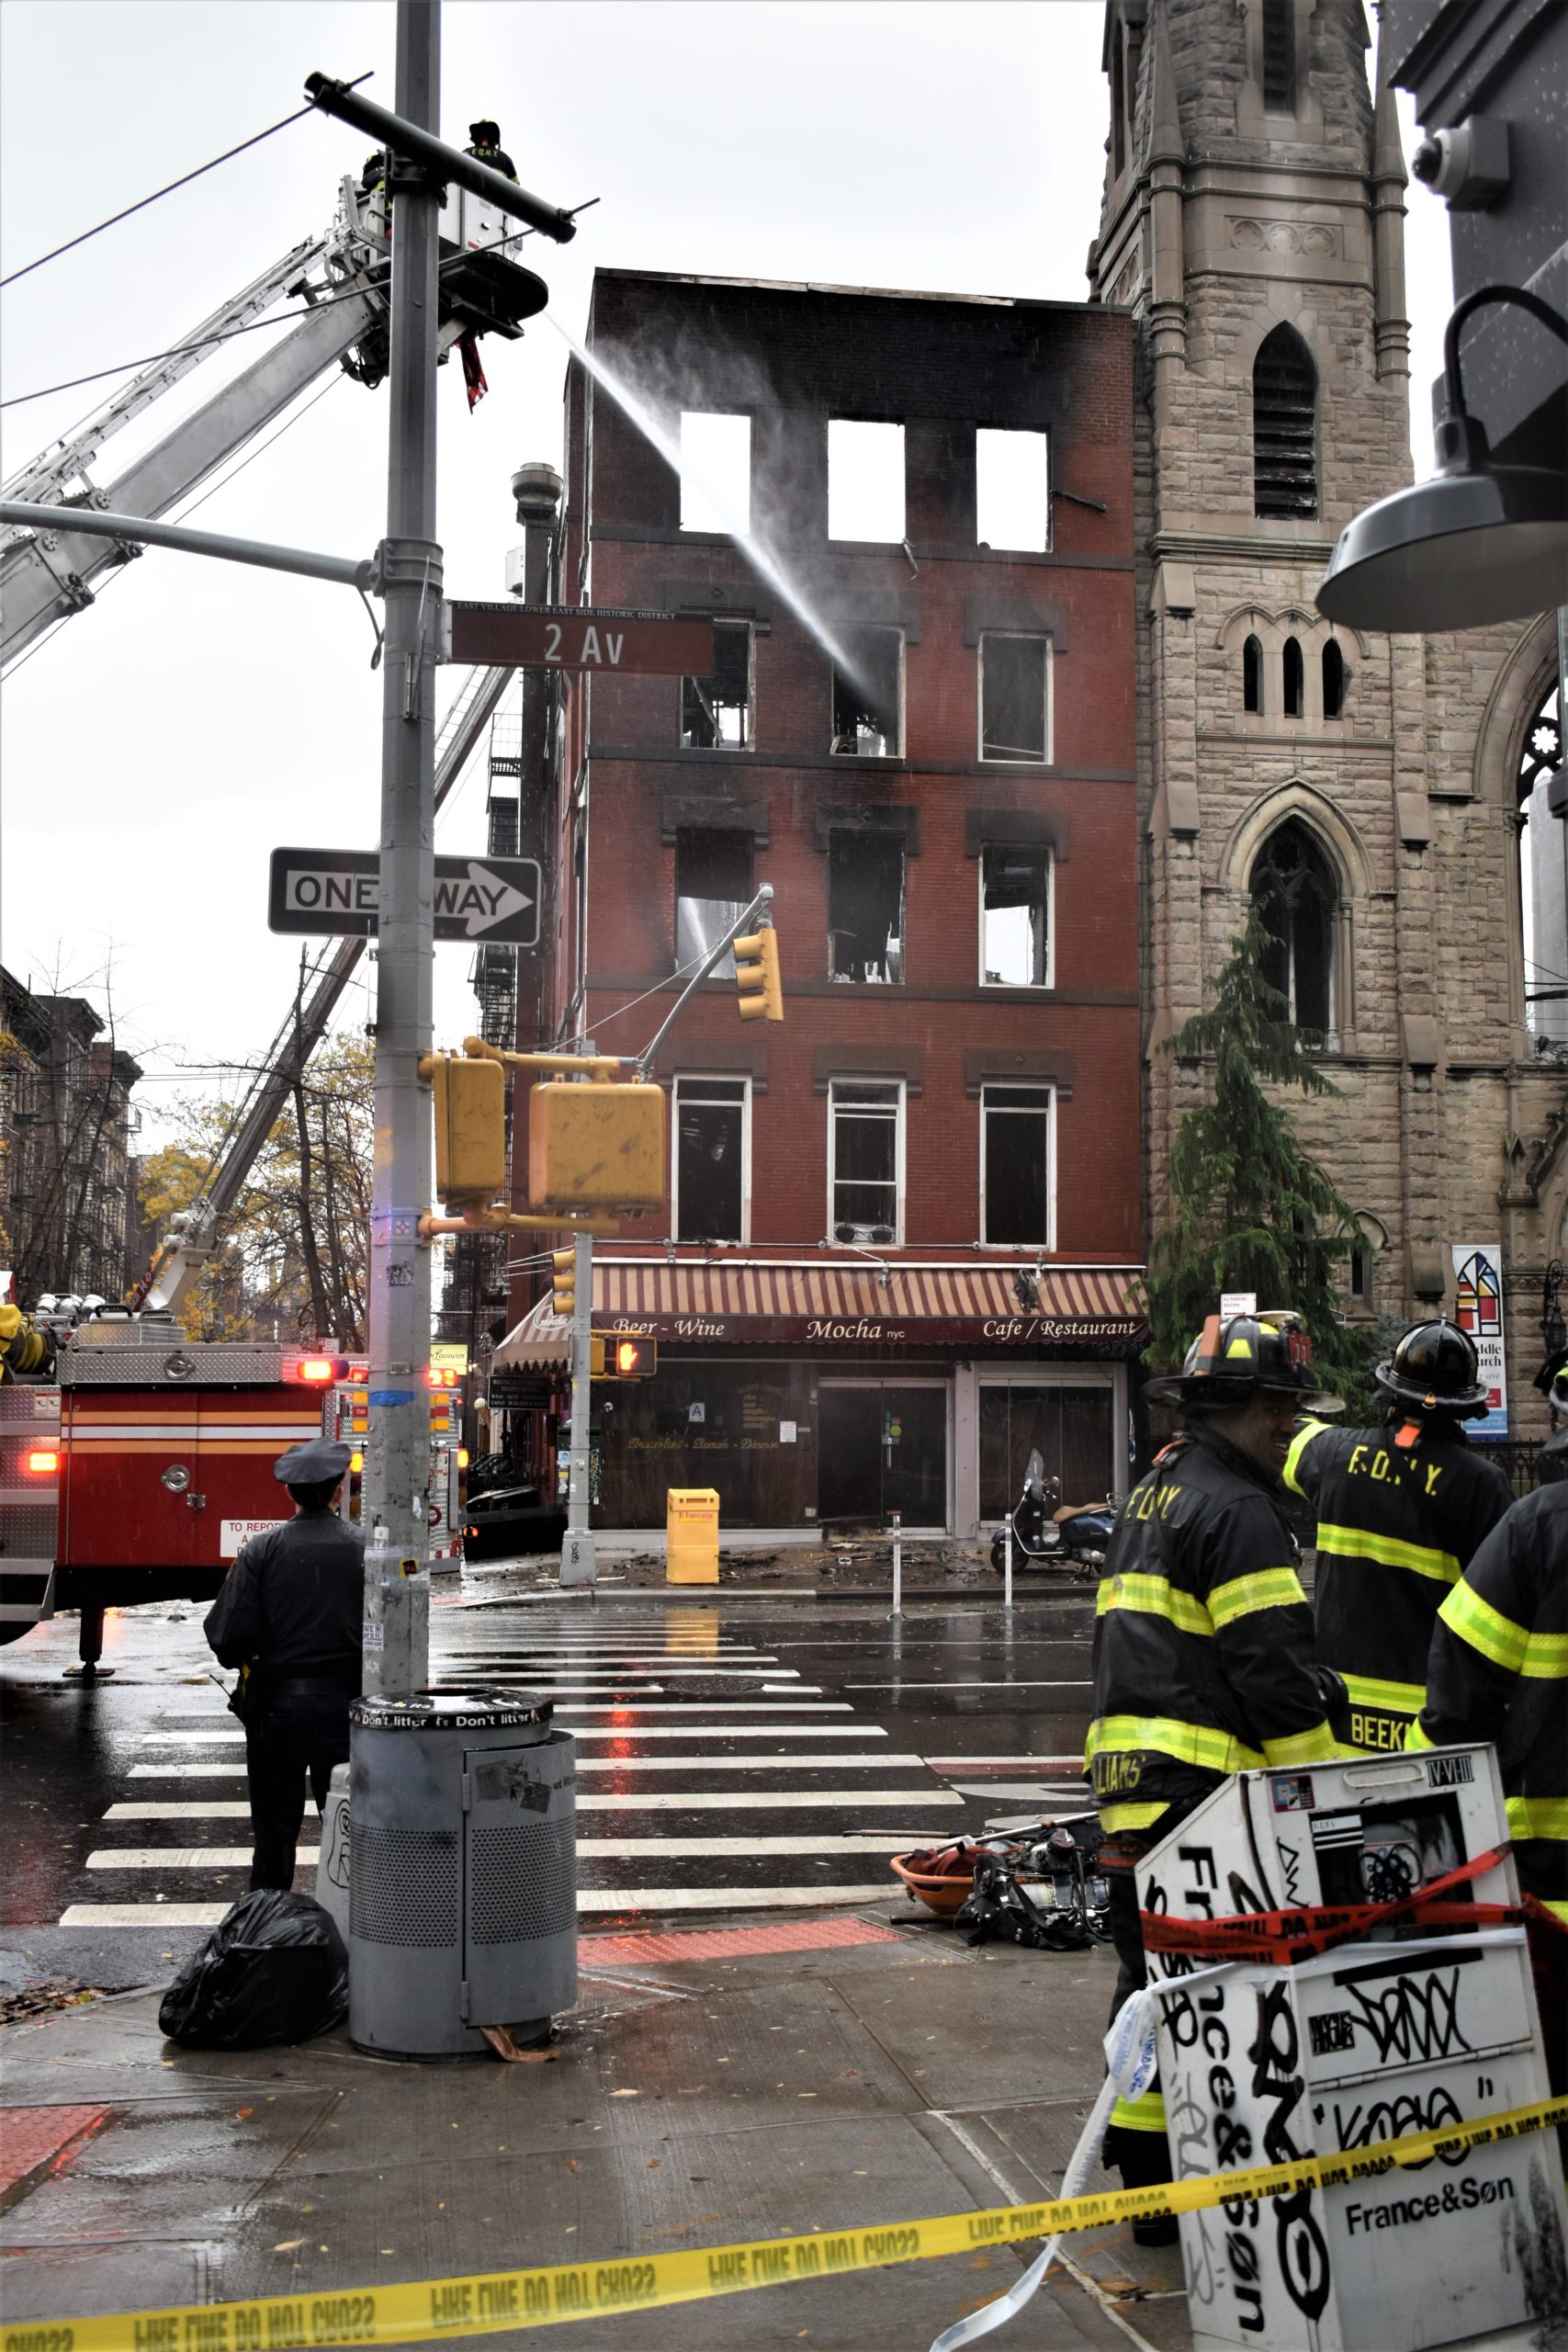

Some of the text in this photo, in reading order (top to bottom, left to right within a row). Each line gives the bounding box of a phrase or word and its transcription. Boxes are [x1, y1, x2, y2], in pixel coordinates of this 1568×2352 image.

[552, 606, 573, 616] EAST
[575, 608, 595, 616] SIDE
[596, 609, 636, 618] HISTORIC
[637, 612, 676, 620] DISTRICT
[545, 624, 561, 662] 2
[295, 876, 509, 916] ONE WAY
[613, 1318, 657, 1334] Beer
[674, 1318, 725, 1336] Wine
[807, 1318, 905, 1340] Mocha nyc
[983, 1319, 1021, 1340] Cafe
[1041, 1319, 1137, 1338] Restaurant
[1477, 1344, 1501, 1354] ddle
[1478, 1356, 1501, 1366] urch
[692, 1405, 702, 1417] A
[229, 1522, 281, 1532] TO REPO
[242, 1534, 248, 1544] A
[364, 1633, 381, 1641] MAIL
[362, 1713, 389, 1725] Don't
[456, 1712, 529, 1726] Don't litter
[553, 1780, 562, 1791] ut
[1345, 2176, 1515, 2236] France&Søn
